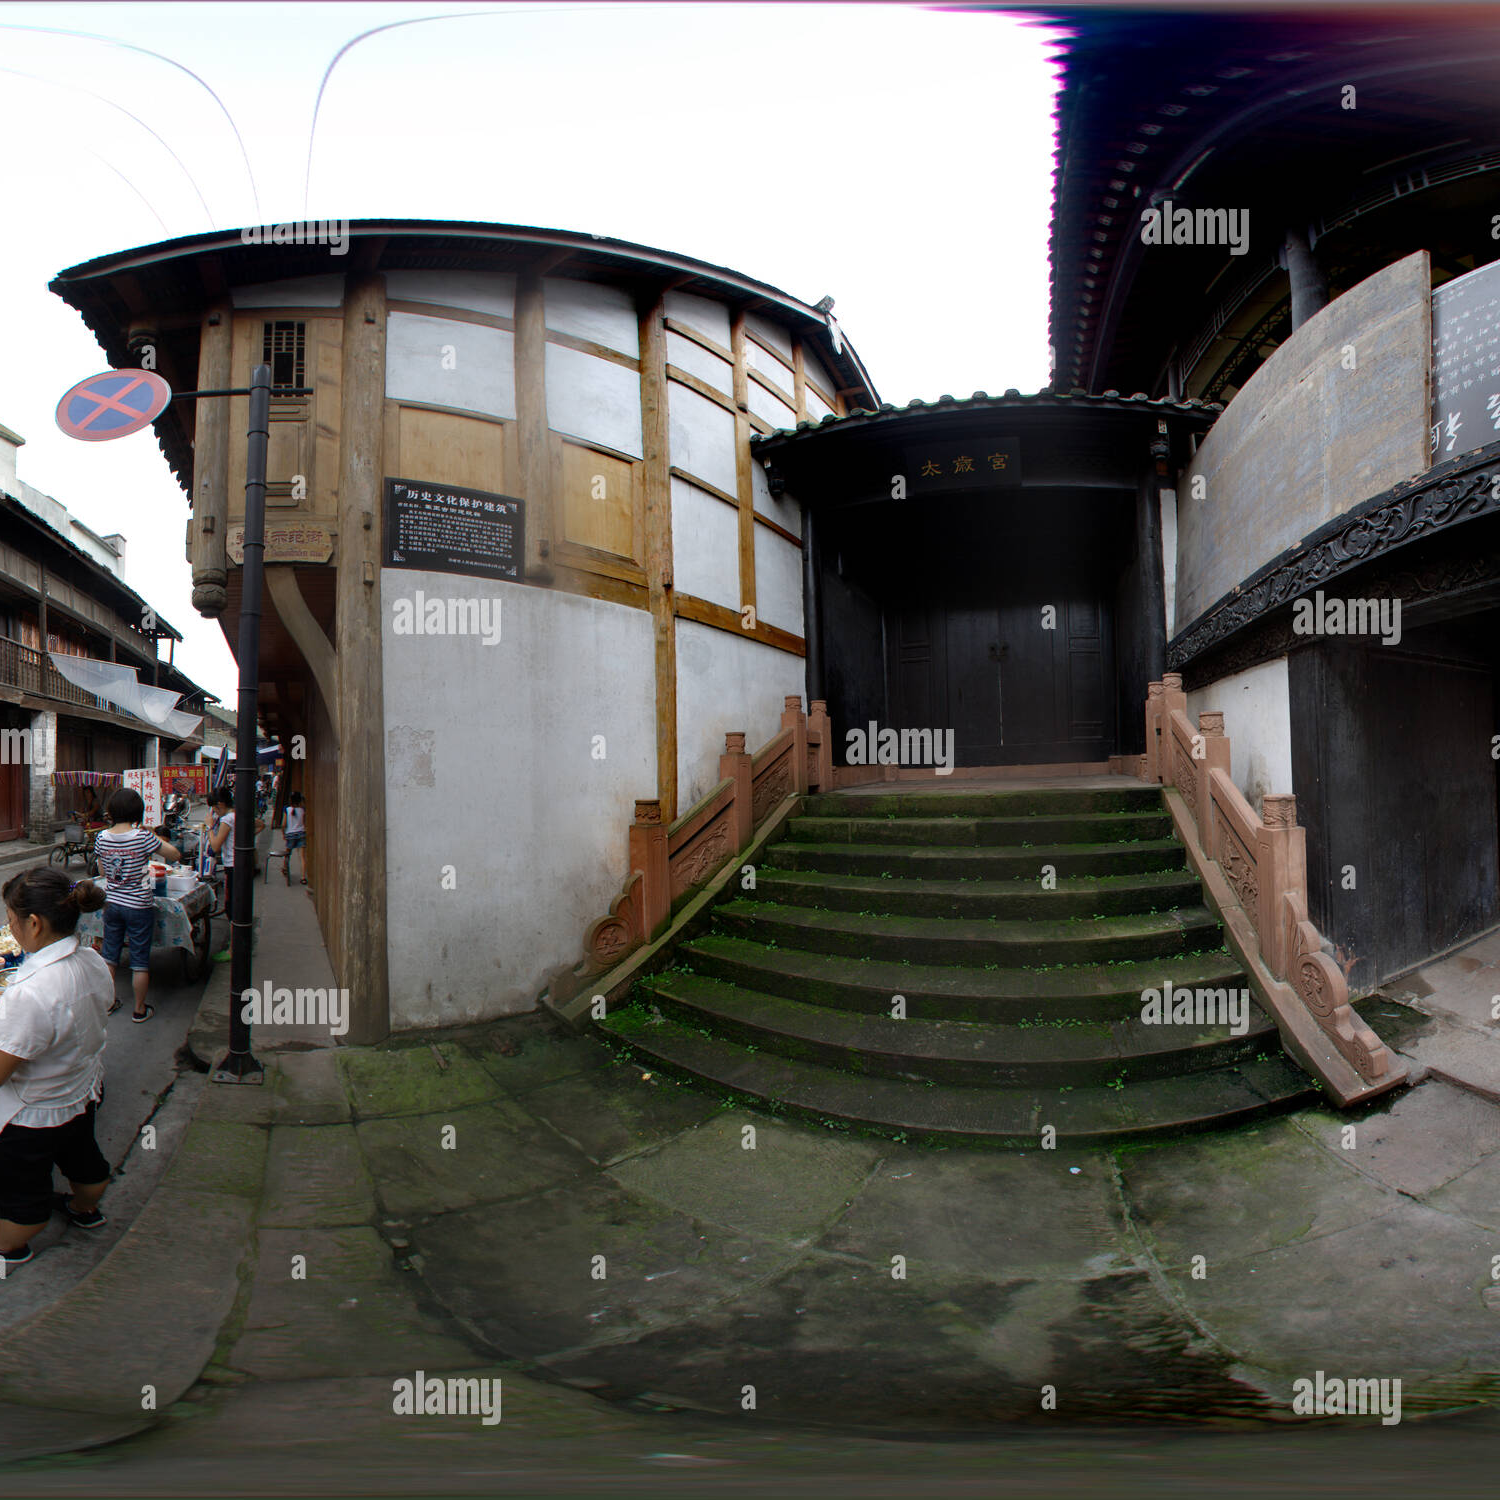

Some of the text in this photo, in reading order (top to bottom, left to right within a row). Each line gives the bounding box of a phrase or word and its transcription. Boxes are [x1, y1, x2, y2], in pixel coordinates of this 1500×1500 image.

[406, 489, 508, 514] 历史文化保护建筑
